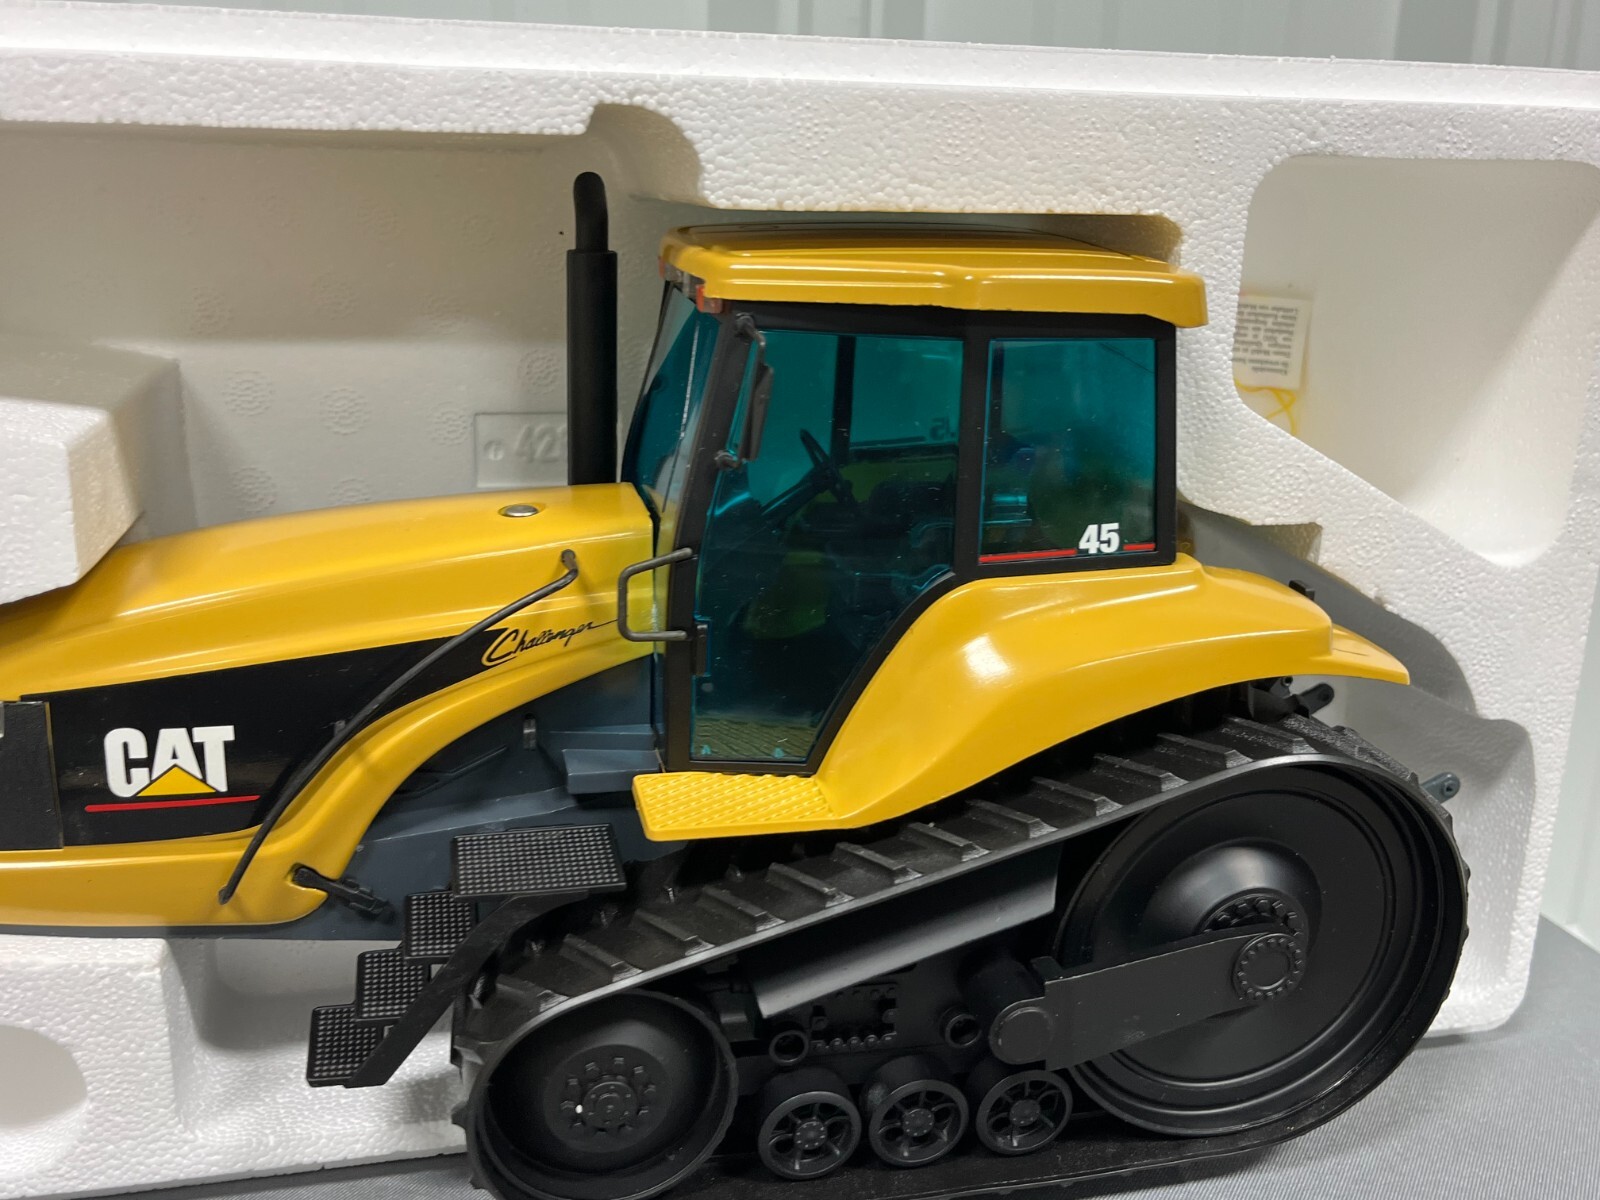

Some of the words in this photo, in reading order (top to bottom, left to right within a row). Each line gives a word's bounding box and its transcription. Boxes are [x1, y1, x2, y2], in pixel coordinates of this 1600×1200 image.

[514, 423, 567, 463] 42
[1079, 523, 1119, 554] 45
[482, 620, 617, 666] Challenger
[104, 725, 235, 797] CAT
